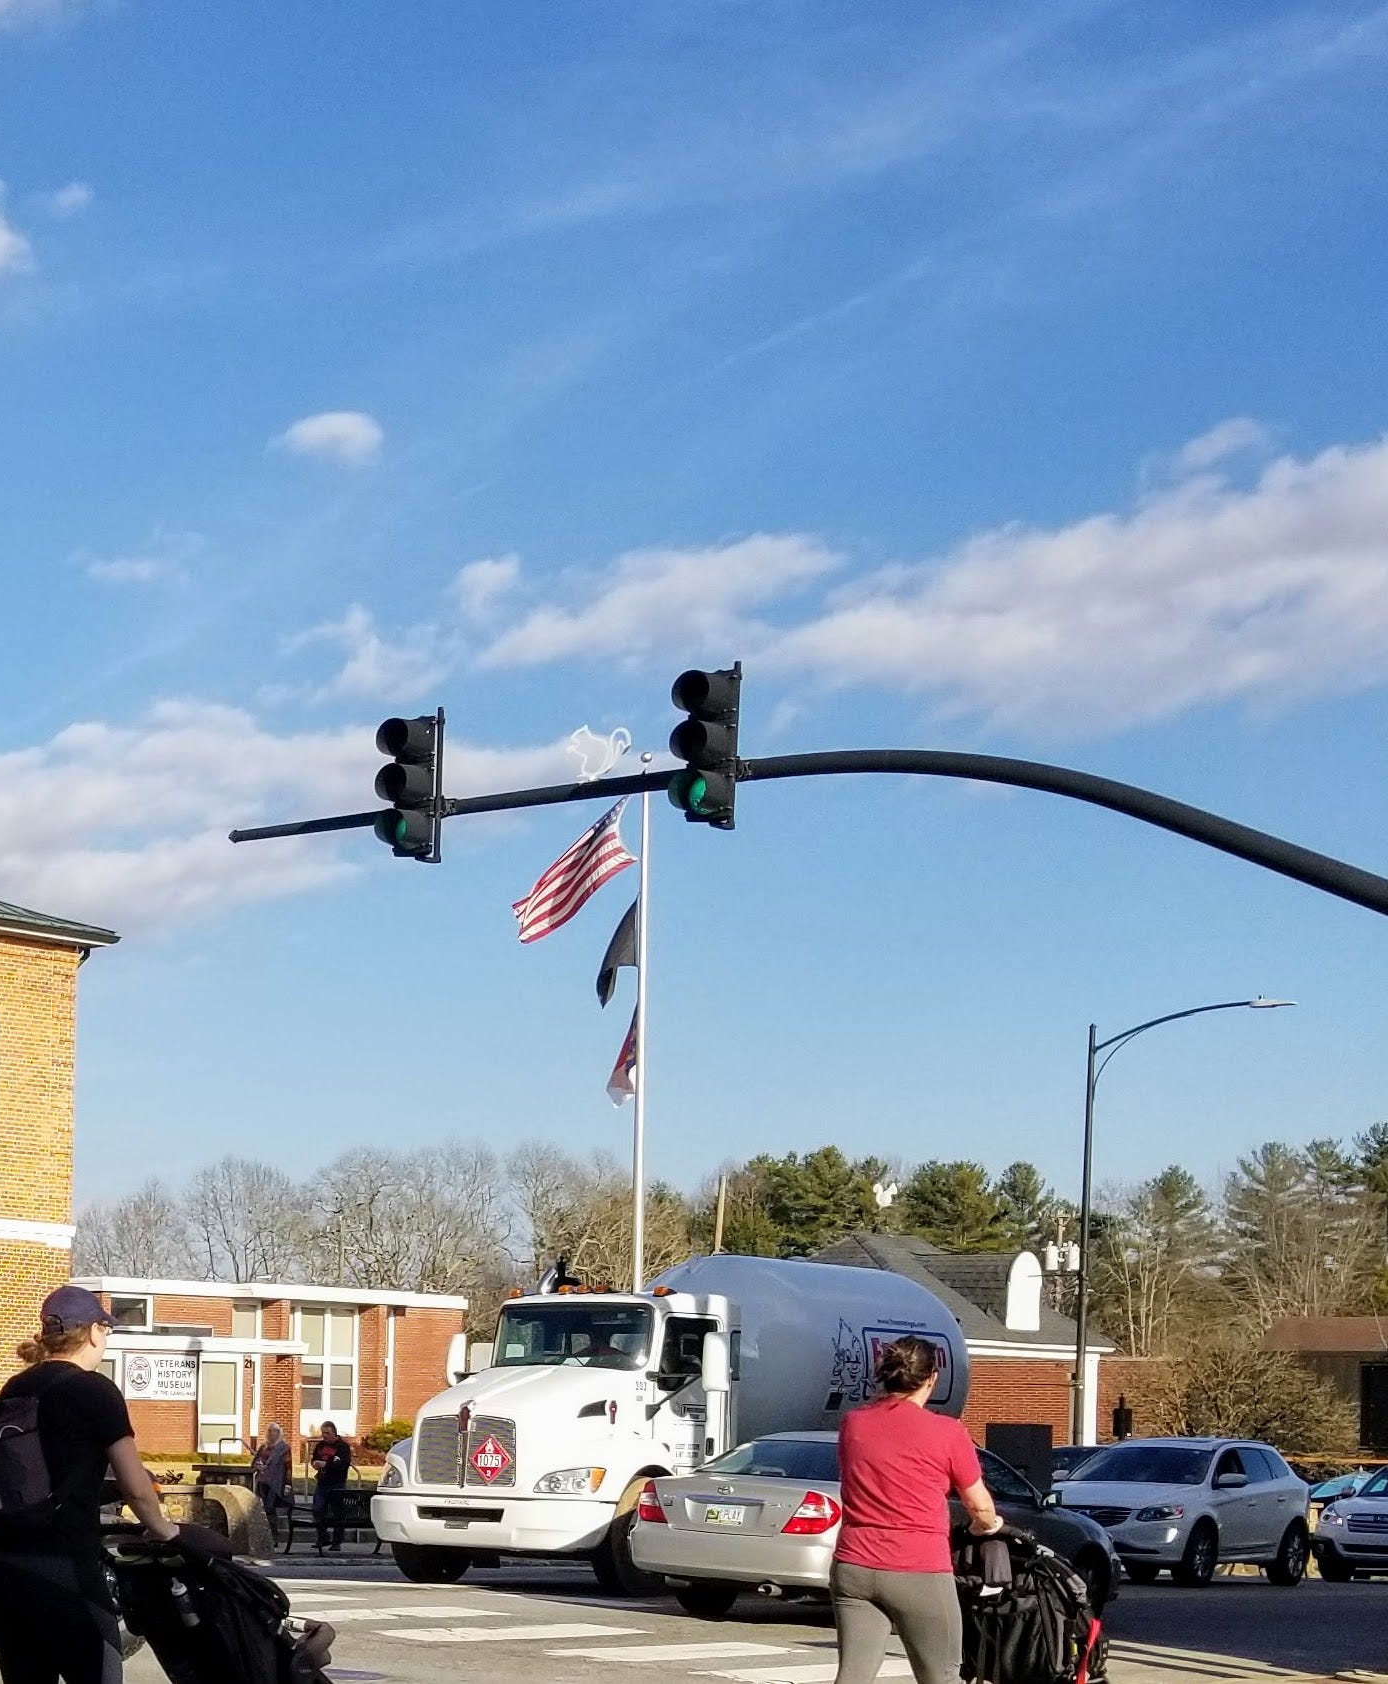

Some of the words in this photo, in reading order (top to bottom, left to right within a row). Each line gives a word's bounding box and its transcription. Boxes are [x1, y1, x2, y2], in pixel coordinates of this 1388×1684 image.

[153, 1359, 196, 1369] VETERANS
[157, 1369, 193, 1379] HISTORY
[157, 1380, 192, 1389] MUSEUM
[478, 1454, 501, 1467] 1075
[485, 1469, 492, 1477] 2
